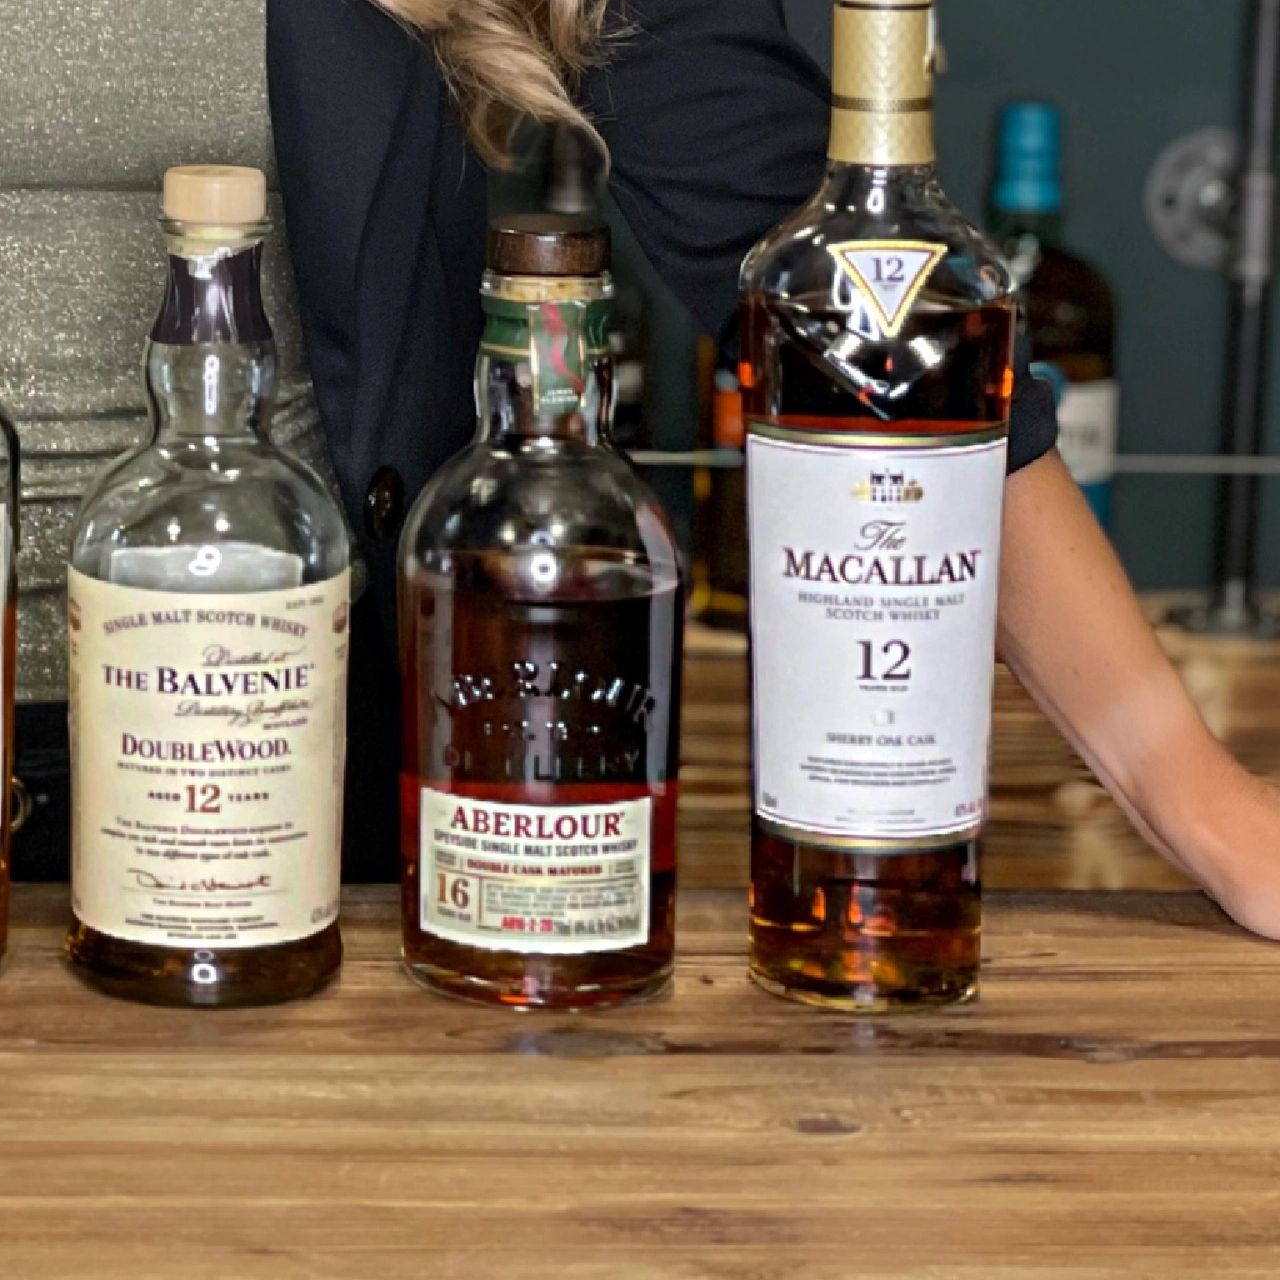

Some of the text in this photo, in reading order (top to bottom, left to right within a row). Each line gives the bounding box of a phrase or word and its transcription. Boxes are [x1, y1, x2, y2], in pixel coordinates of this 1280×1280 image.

[872, 257, 905, 282] 12
[854, 519, 907, 553] The
[782, 546, 982, 586] MACALLAN
[798, 591, 965, 608] HIGHLAND SINGLE MALT
[825, 608, 941, 621] SCOTCH WHISKY
[103, 608, 308, 638] SINGLE MALT SCOTCH WHISKY
[856, 638, 912, 682] 12
[102, 664, 310, 696] THE BALVENIE
[826, 732, 873, 746] SHERRY
[876, 734, 903, 746] OAK
[148, 784, 270, 814] AGED 12 YEARS
[451, 806, 621, 840] ABERLOUR
[481, 839, 519, 855] SINGLE
[524, 844, 551, 857] MALT
[555, 843, 598, 857] SCOTCH
[467, 858, 603, 875] DOUBLE CASK MATURED
[437, 872, 470, 909] 16
